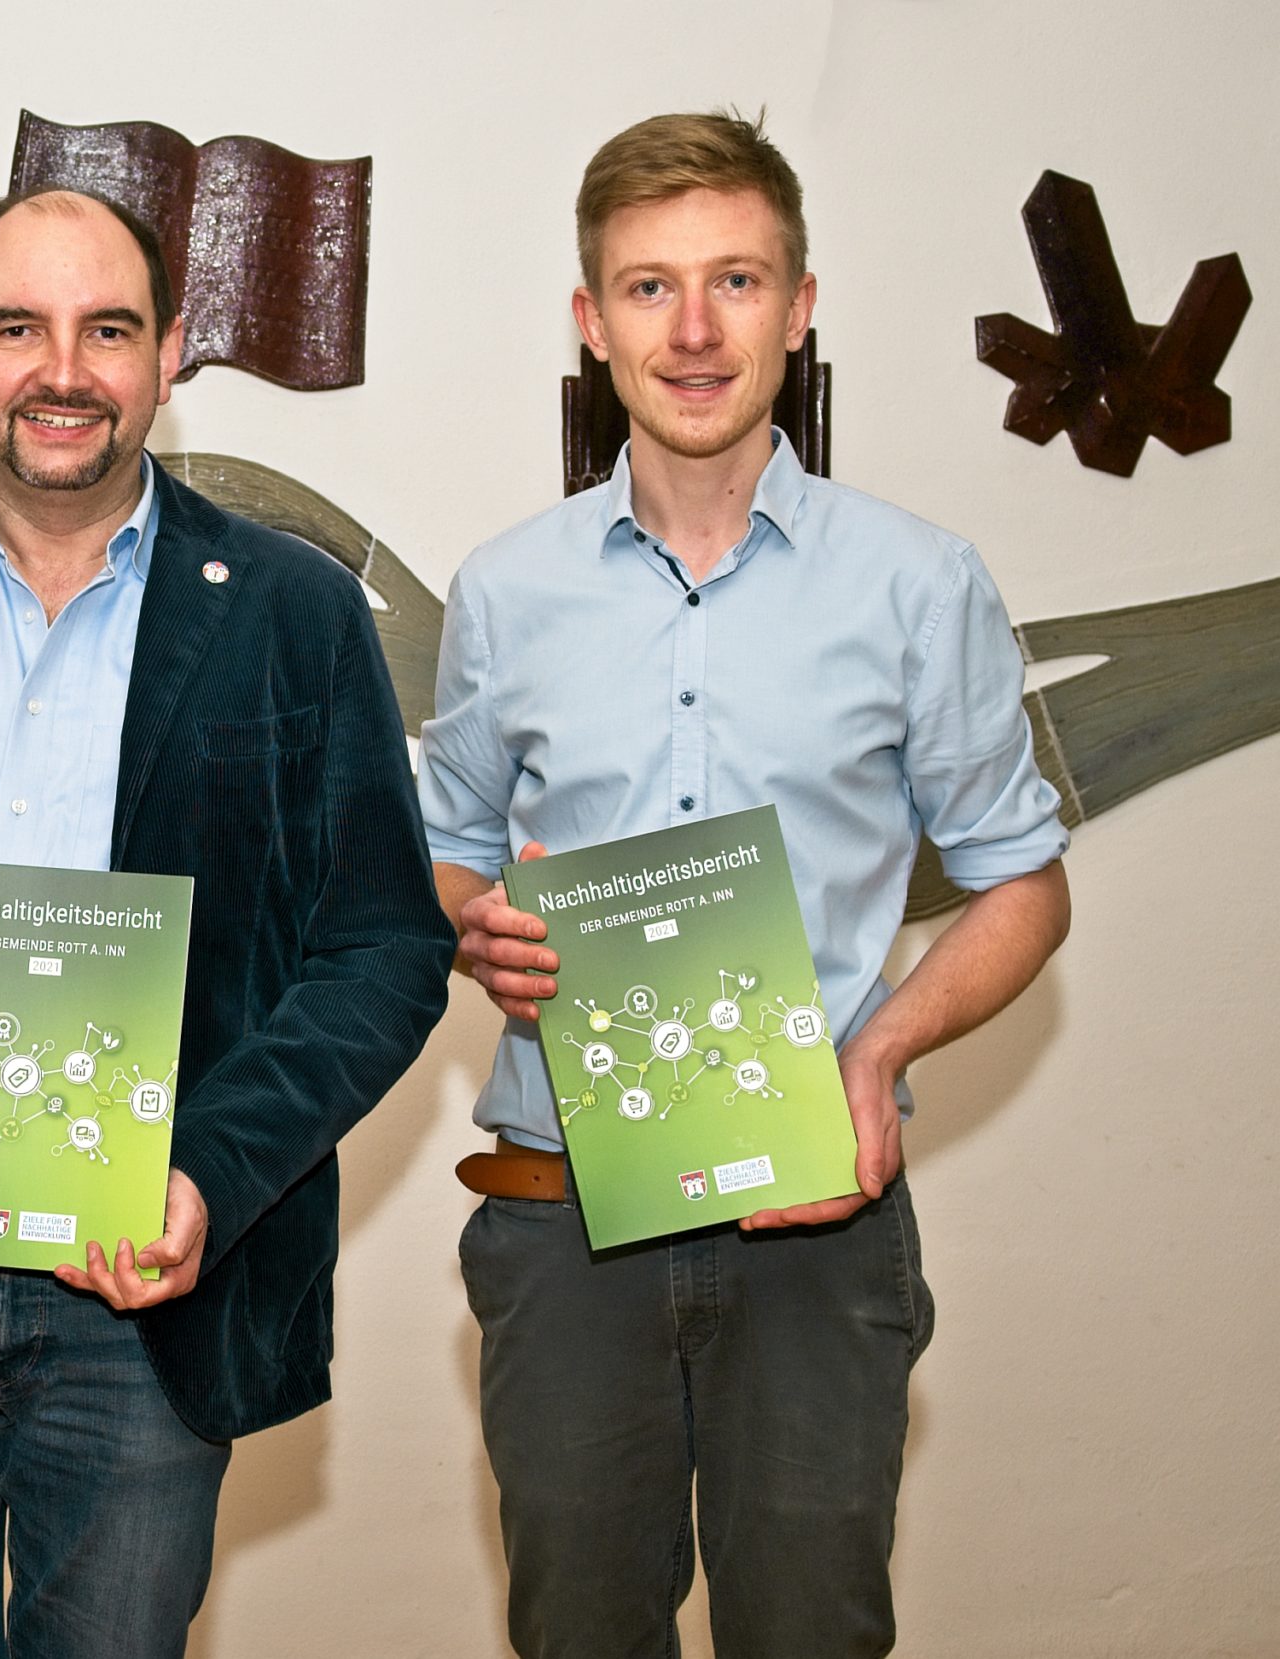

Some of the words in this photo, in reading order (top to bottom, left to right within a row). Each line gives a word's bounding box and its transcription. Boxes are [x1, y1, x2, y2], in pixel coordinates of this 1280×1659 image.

[538, 844, 761, 913] Nachhaltigkeitsbericht
[579, 920, 603, 934] DER
[604, 904, 665, 929] GEMEINDE
[666, 896, 696, 914] ROTT
[698, 894, 711, 907] A.
[713, 888, 734, 903] INN
[647, 923, 676, 939] 2021
[57, 941, 88, 954] ROTT
[90, 943, 101, 955] A.
[105, 944, 126, 957] INN
[32, 960, 60, 973] 2021
[718, 1166, 740, 1176] ZIELE
[741, 1162, 757, 1171] FÜR
[719, 1167, 768, 1183] NACHHALTIGE
[721, 1175, 770, 1190] ENTWICKLUNG
[23, 1215, 46, 1224] ZIELE
[46, 1216, 62, 1225] FÜR
[21, 1231, 71, 1240] ENTWICKLUNG
[22, 1224, 72, 1233] NACHHALTIGE
